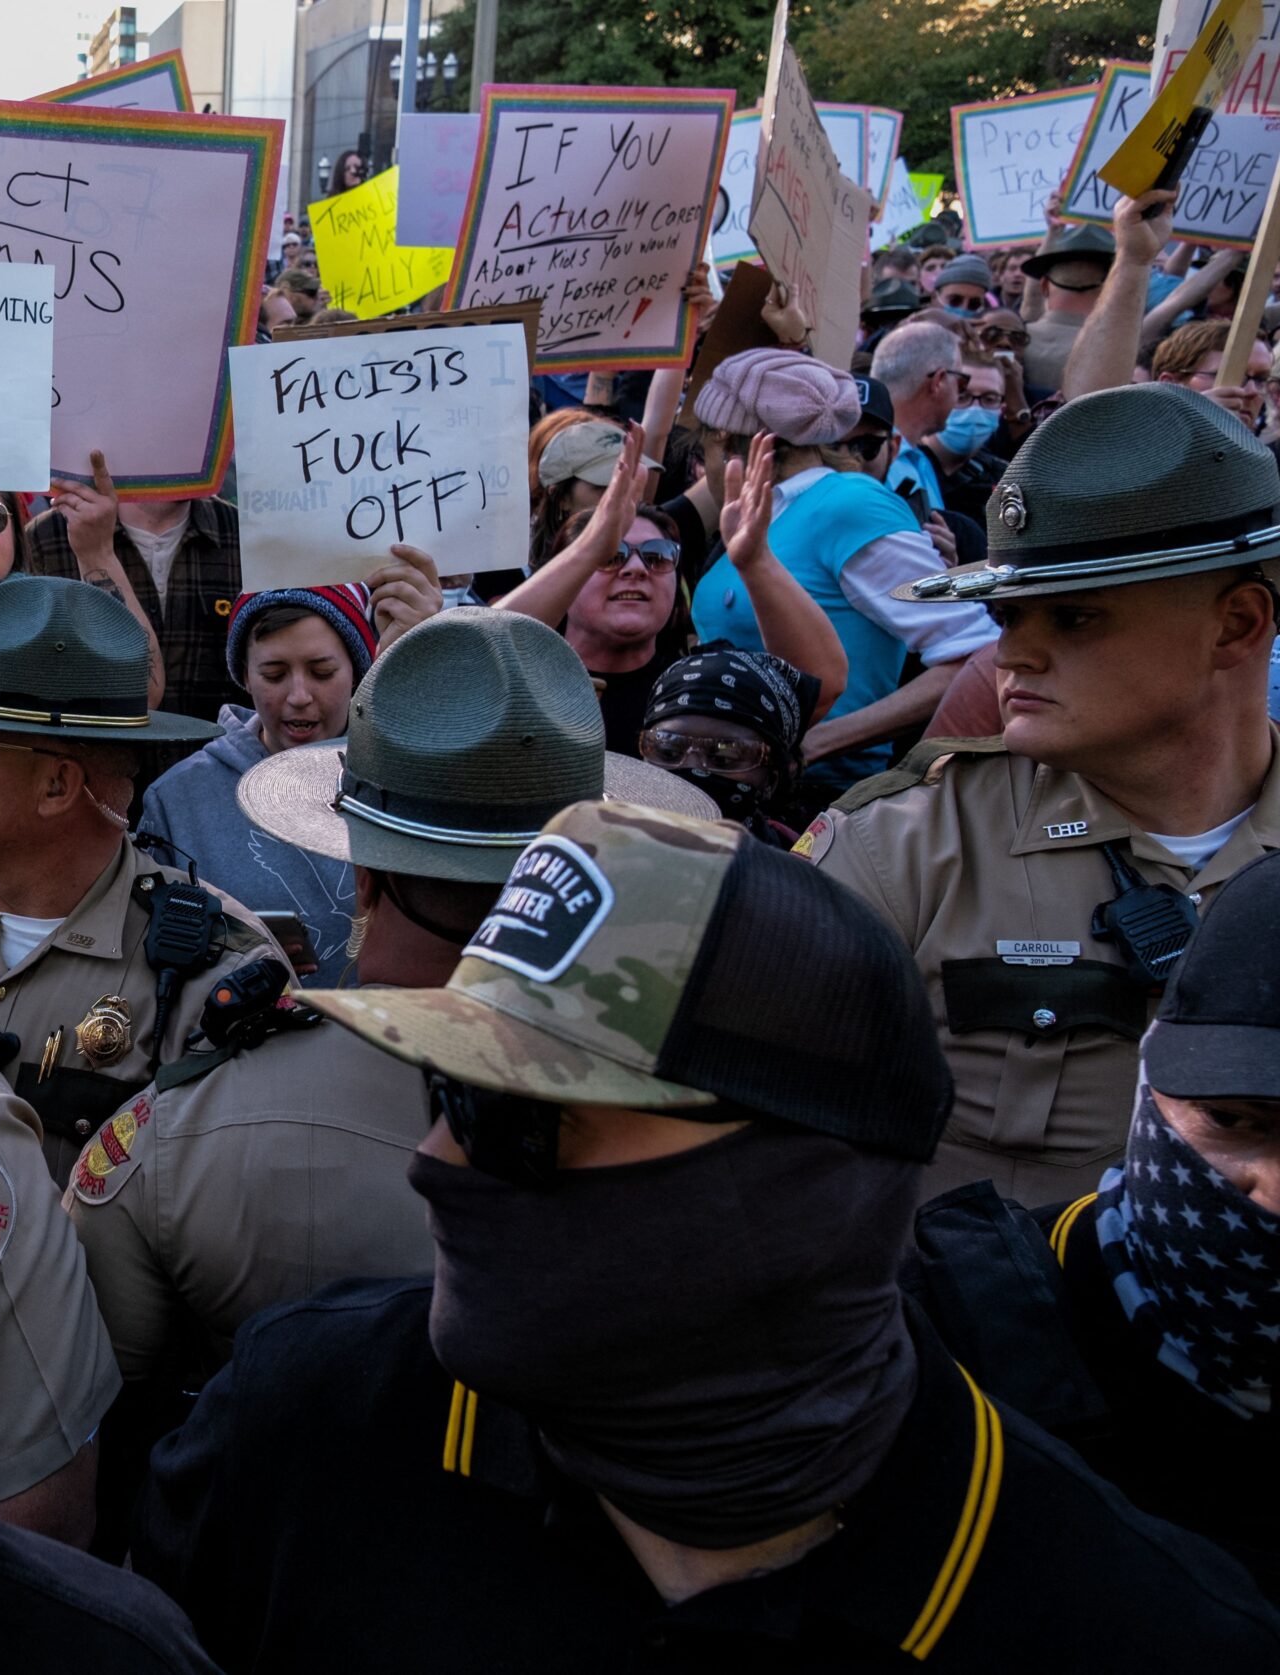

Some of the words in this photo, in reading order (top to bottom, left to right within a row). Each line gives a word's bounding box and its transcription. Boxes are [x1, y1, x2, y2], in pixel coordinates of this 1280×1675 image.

[505, 123, 578, 191] IF
[593, 120, 672, 197] YOU
[315, 198, 378, 237] TRANS
[333, 251, 417, 310] #ALLY
[270, 345, 469, 415] FACISTS
[292, 419, 431, 484] FUCK
[346, 470, 486, 543] OFF!
[1014, 942, 1063, 953] CARROLL
